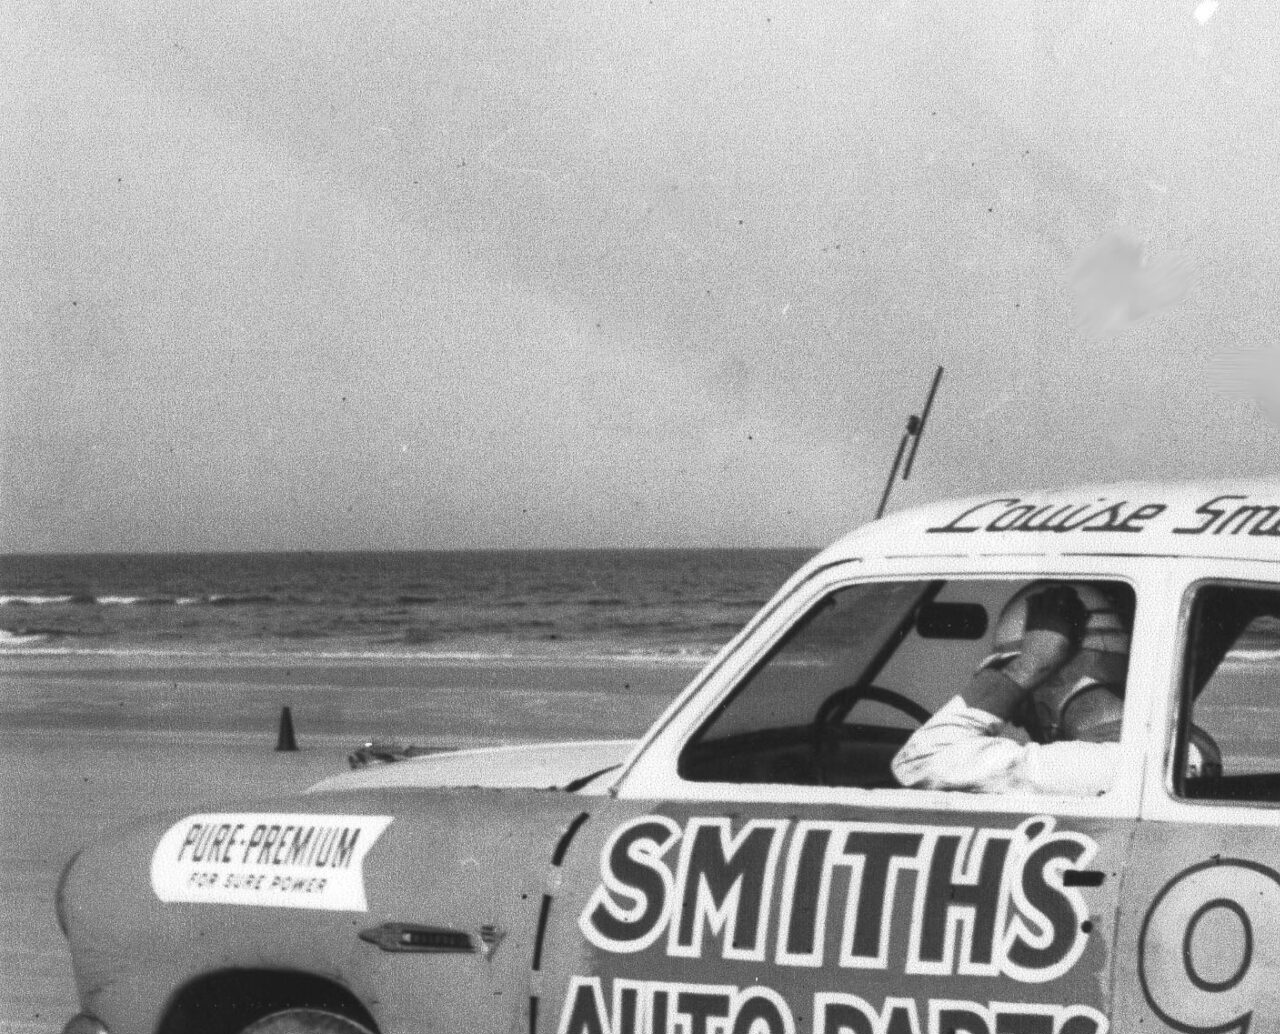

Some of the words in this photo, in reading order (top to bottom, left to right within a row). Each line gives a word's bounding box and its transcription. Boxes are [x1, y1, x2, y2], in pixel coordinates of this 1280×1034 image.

[926, 498, 1167, 534] Louise
[177, 823, 361, 869] PURE-PREMIUM
[189, 871, 218, 888] FOR
[224, 873, 266, 892] SURE
[270, 875, 327, 894] POWER
[579, 814, 1100, 983] SMITH'S
